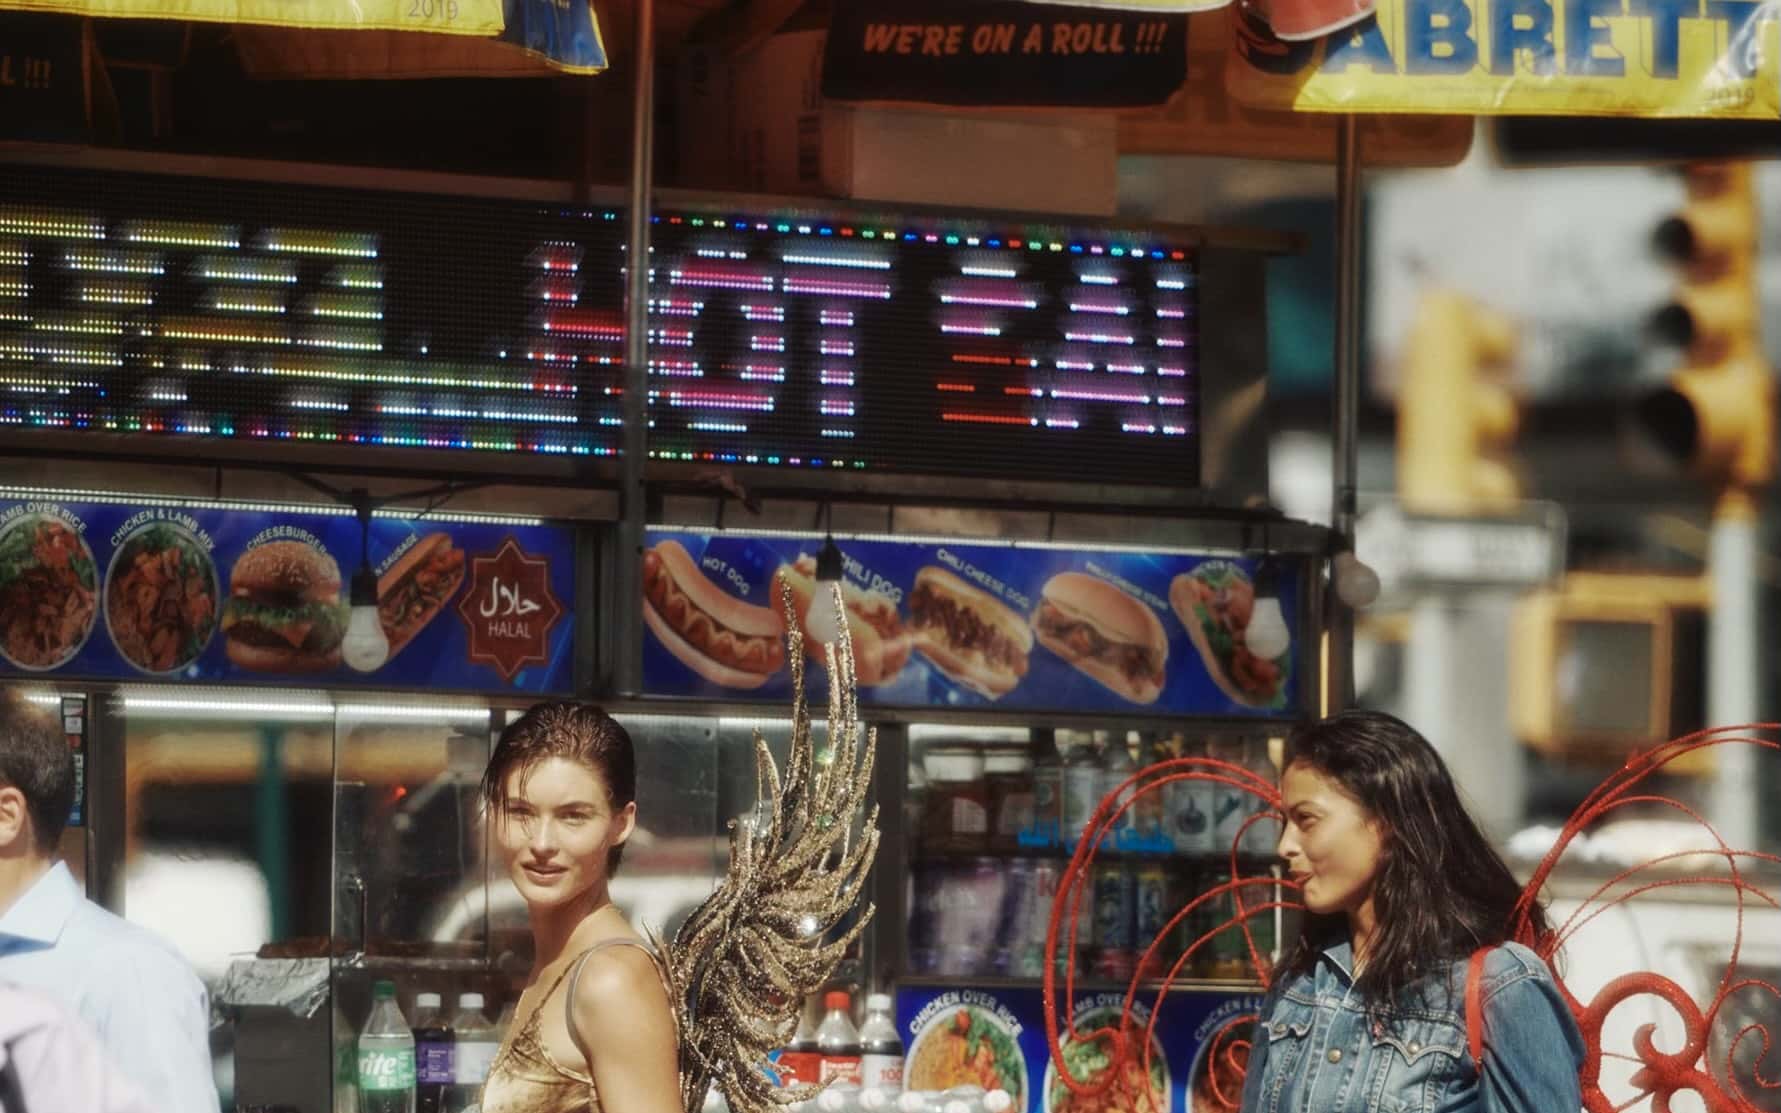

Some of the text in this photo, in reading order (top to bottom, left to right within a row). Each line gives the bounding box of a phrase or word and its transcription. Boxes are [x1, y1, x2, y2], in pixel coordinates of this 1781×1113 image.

[863, 24, 964, 56] WE'RE
[972, 24, 1017, 53] ON
[1022, 24, 1044, 53] A
[1051, 23, 1125, 55] ROLL
[0, 502, 87, 532] AMB OVER RICE
[110, 510, 154, 547] CHICKEN
[167, 509, 199, 532] LAMB
[702, 556, 750, 596] HOT DOG
[871, 572, 903, 604] DOG
[480, 577, 542, 618] حلال
[488, 620, 532, 639] HALAL
[909, 990, 960, 1035] CHICKEN
[962, 989, 998, 1011] OVER
[361, 1051, 398, 1076] rite
